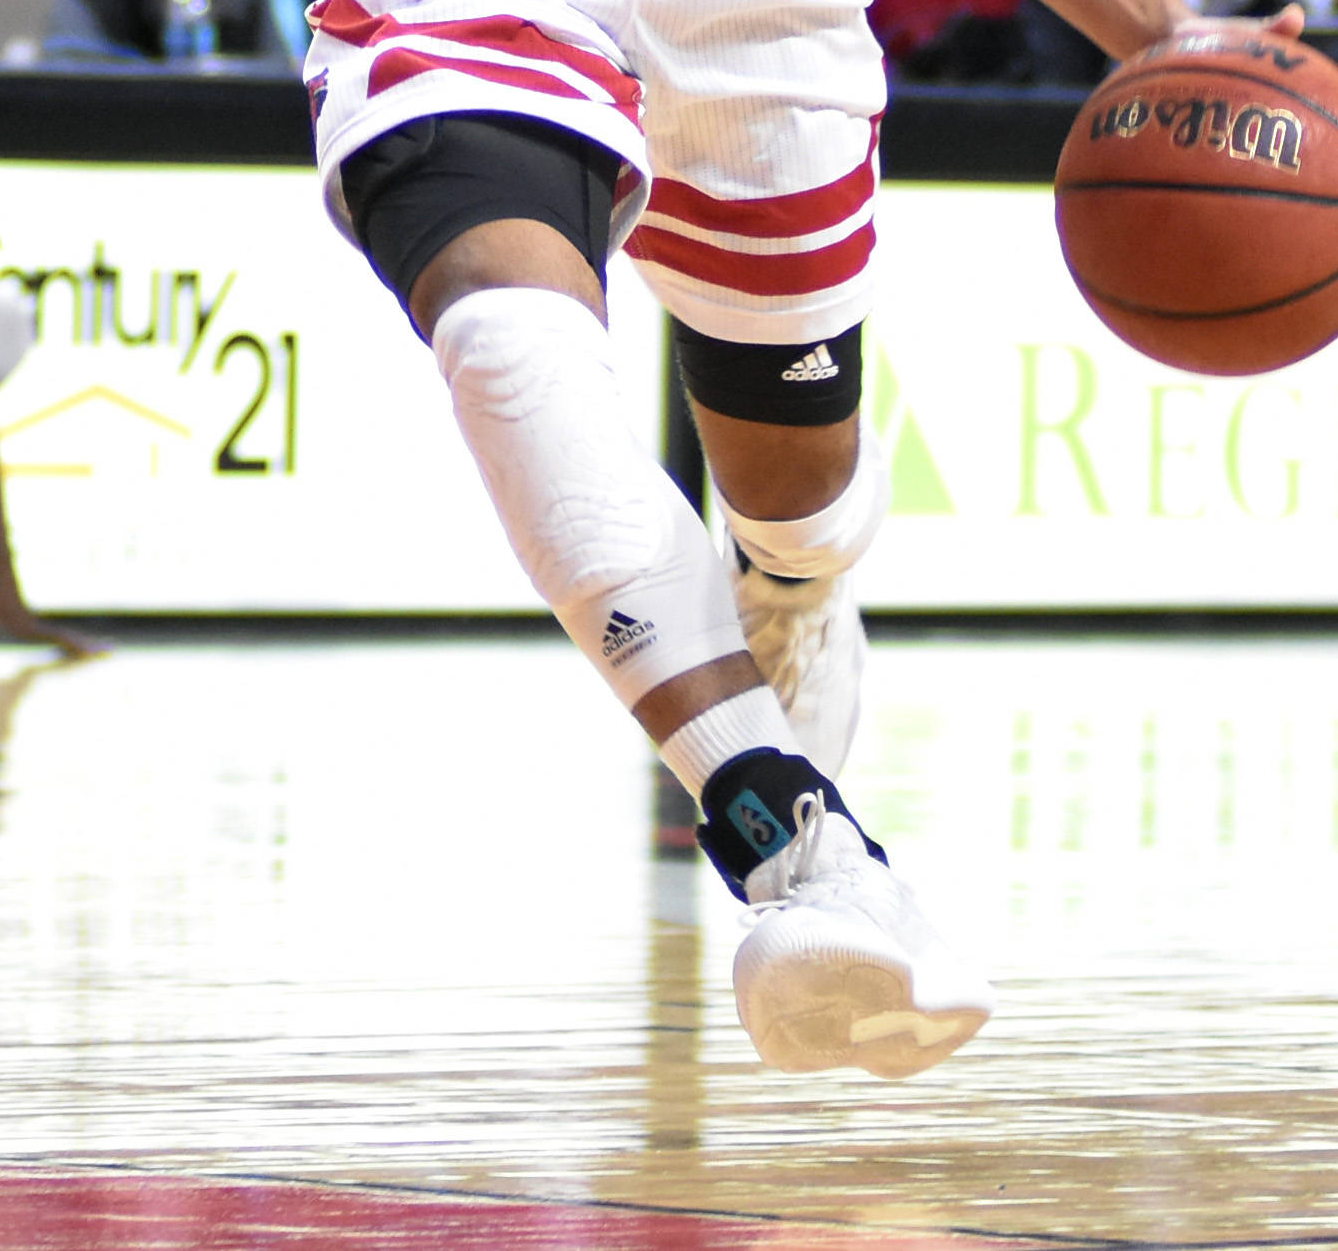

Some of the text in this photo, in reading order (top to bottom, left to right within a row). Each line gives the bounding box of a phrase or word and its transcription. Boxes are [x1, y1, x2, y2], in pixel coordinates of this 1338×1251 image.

[1090, 95, 1303, 176] Wilson
[780, 364, 840, 382] adidas
[212, 330, 300, 478] 21
[602, 620, 655, 657] adidas
